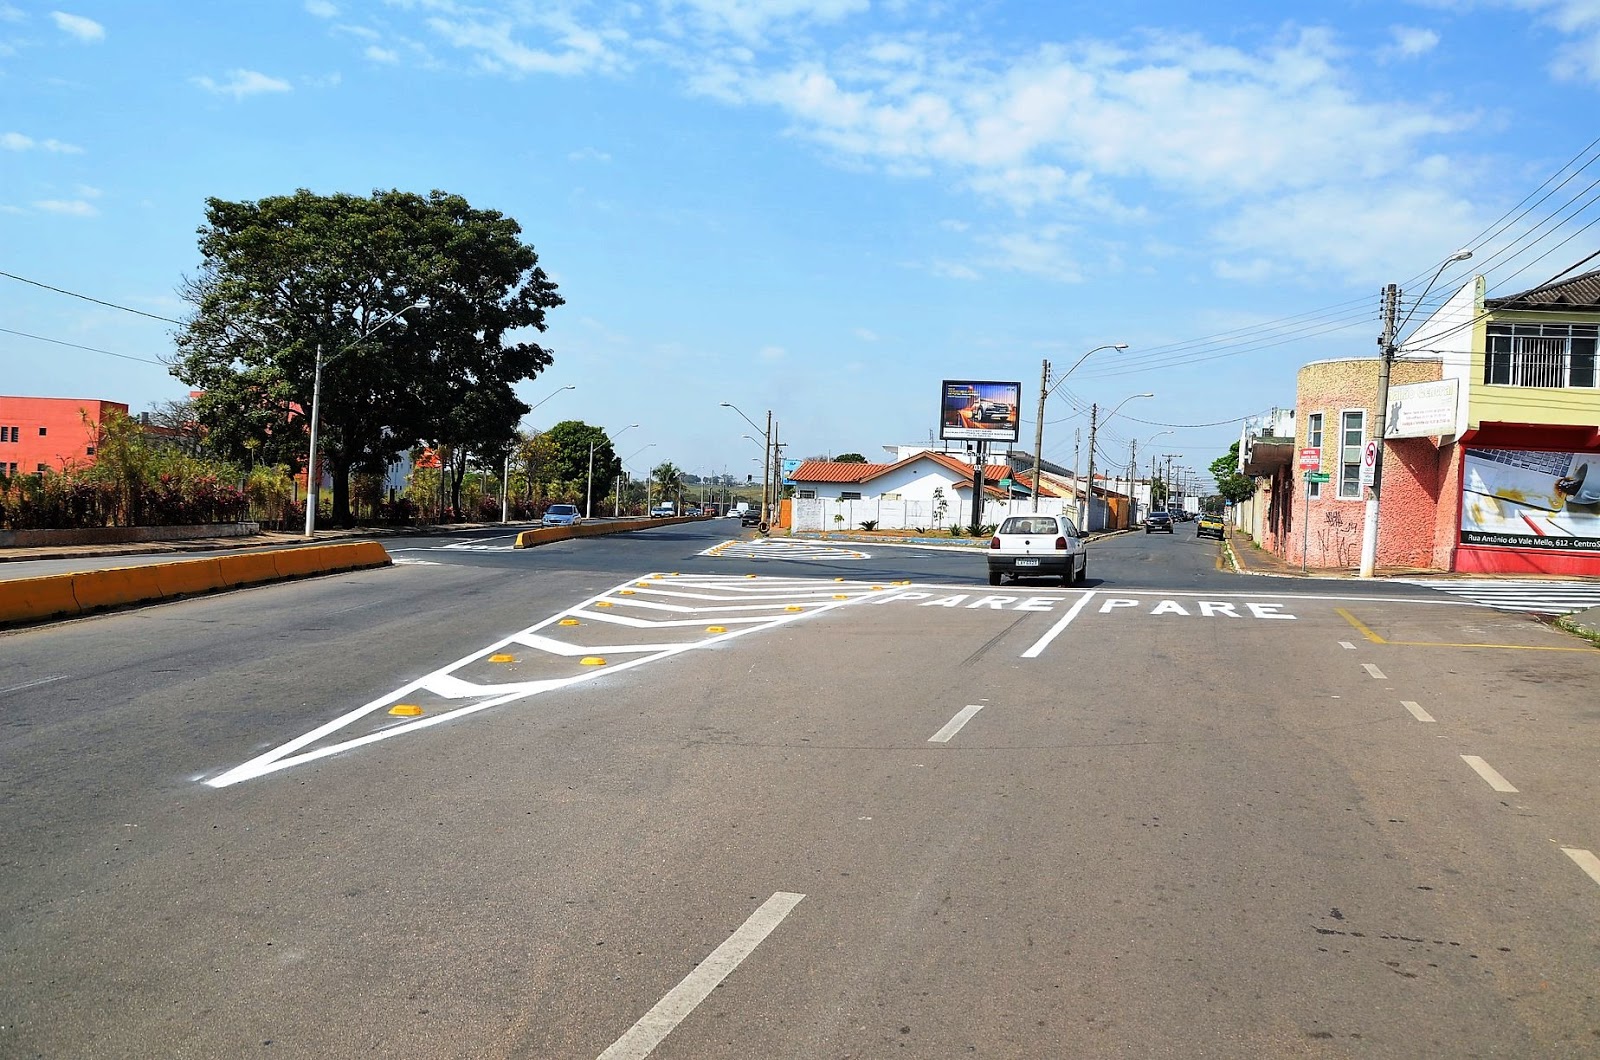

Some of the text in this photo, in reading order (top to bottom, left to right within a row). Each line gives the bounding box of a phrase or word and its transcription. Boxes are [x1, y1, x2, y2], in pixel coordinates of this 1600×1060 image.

[1468, 534, 1480, 542] Rua
[1482, 535, 1507, 544] Antônio
[1508, 536, 1517, 544] do
[1518, 537, 1533, 545] Vale
[1533, 538, 1554, 547] Mello,
[1555, 539, 1568, 547] 612
[870, 591, 1066, 611] PARE
[1098, 599, 1298, 619] PARE
